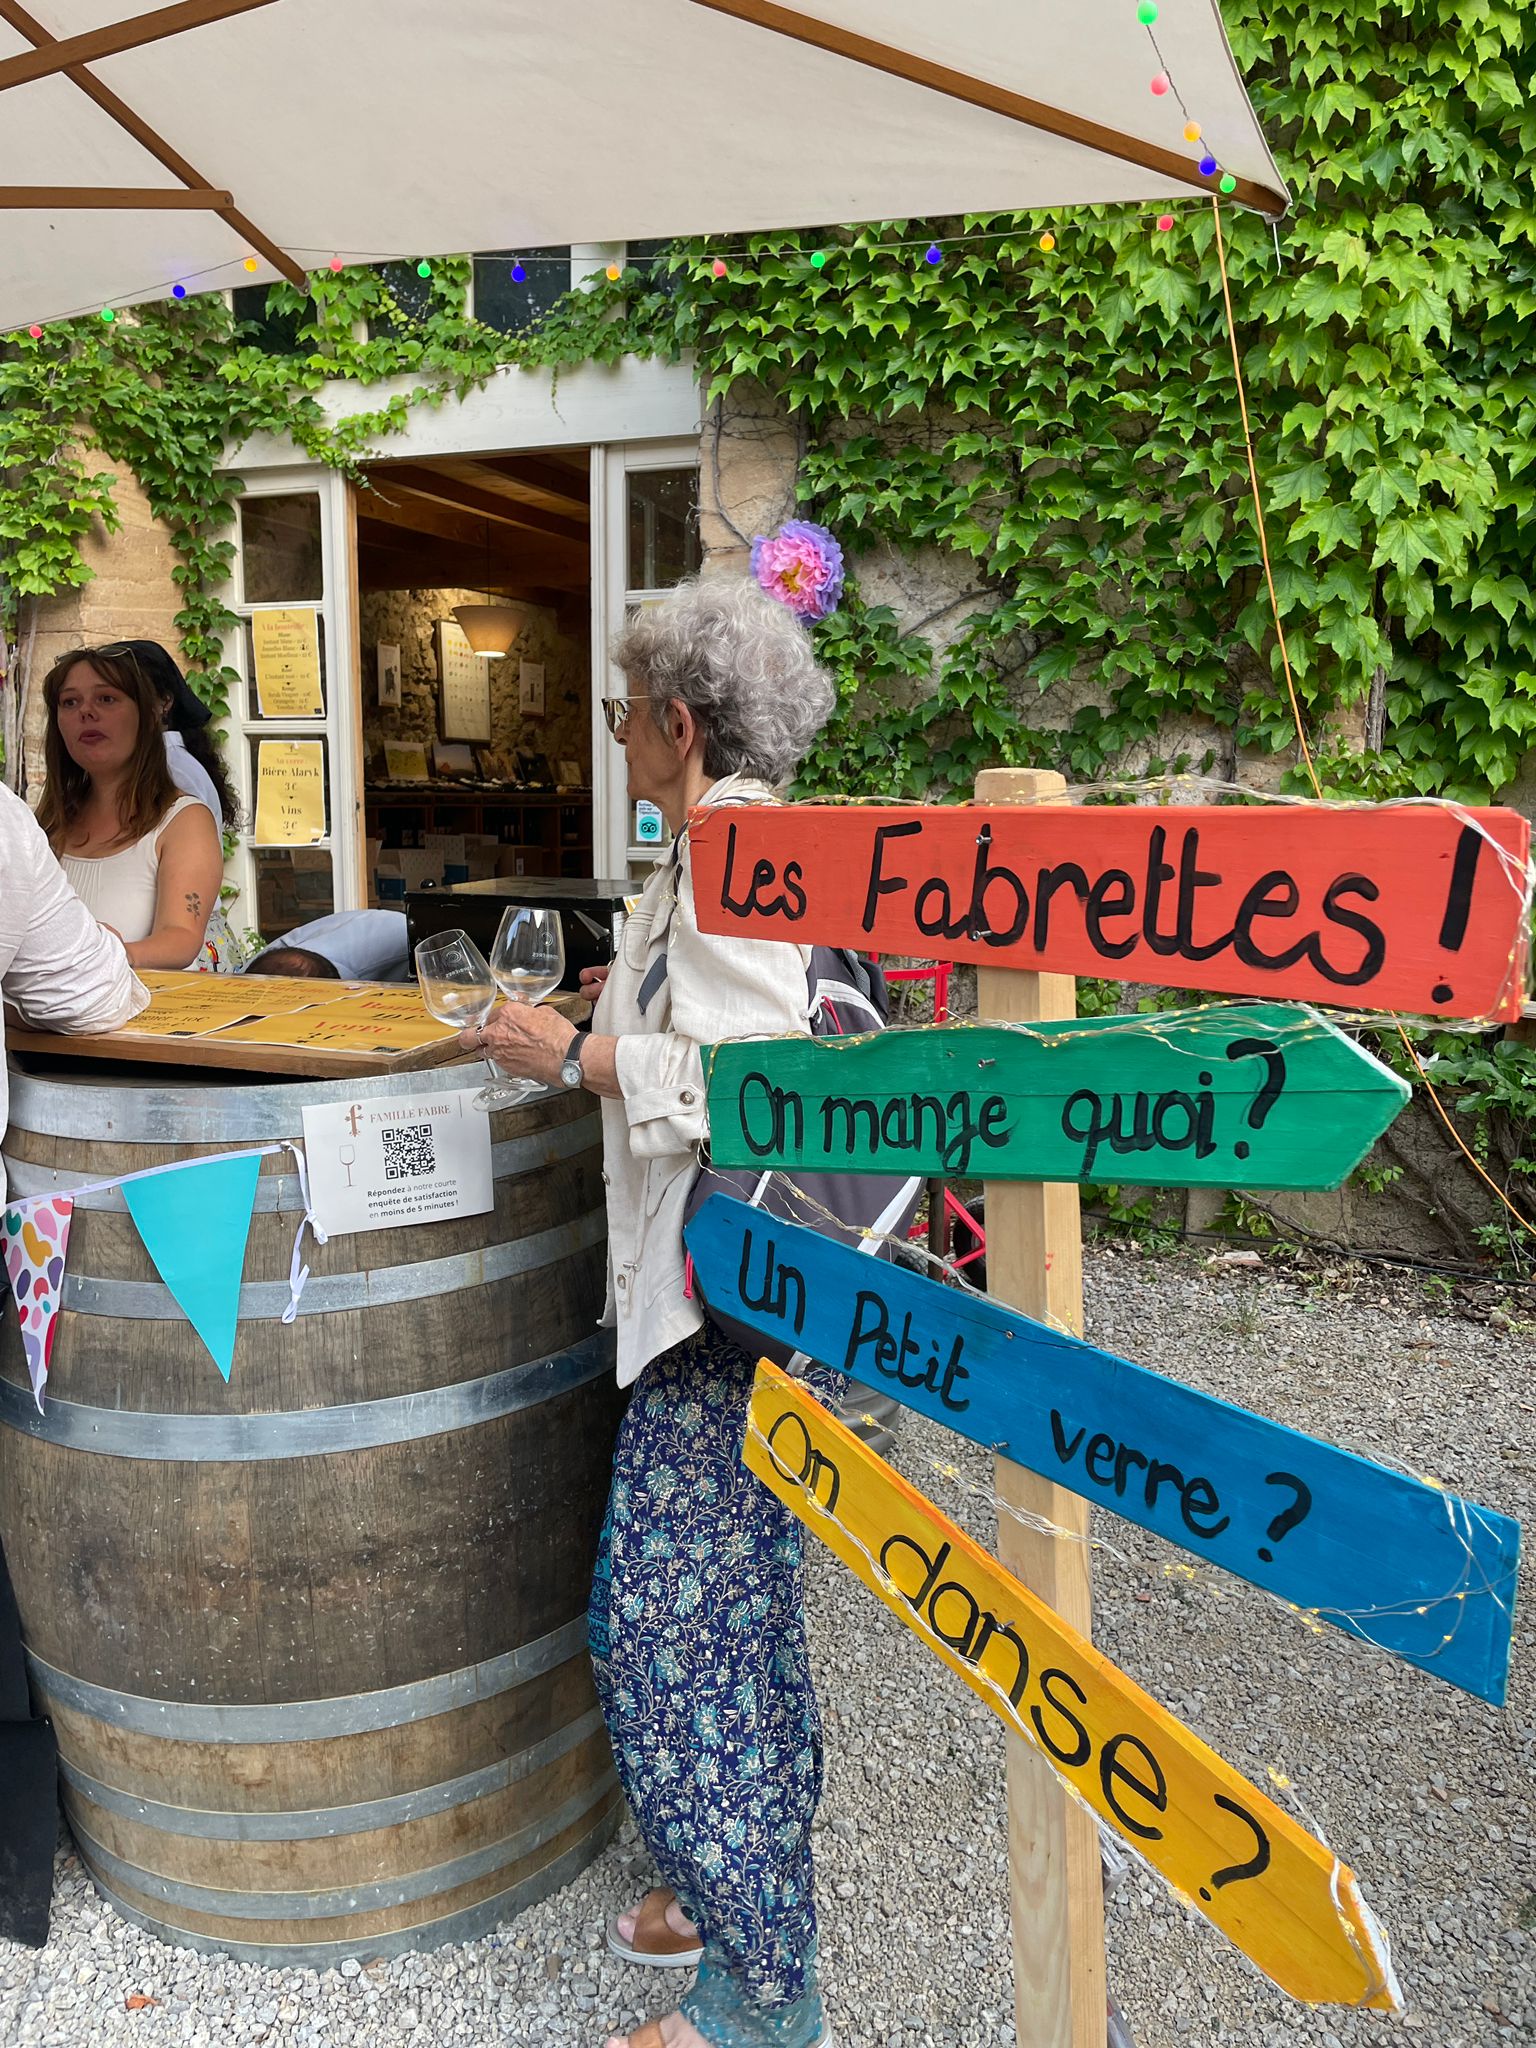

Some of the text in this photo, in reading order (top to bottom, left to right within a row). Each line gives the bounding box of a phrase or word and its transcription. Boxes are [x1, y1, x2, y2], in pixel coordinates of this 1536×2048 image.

[281, 806, 302, 815] Vins
[721, 820, 1482, 1004] Les Fabrettes !
[370, 1104, 451, 1123] FAMILLE FABRE
[739, 1070, 805, 1157] On
[819, 1090, 1015, 1176] mange
[367, 1186, 406, 1199] Répondez
[413, 1183, 433, 1191] notre
[434, 1178, 457, 1188] courte
[368, 1189, 458, 1209] enquête de satisfaction
[369, 1211, 379, 1219] en
[380, 1207, 405, 1217] moins
[406, 1206, 416, 1214] de
[424, 1200, 455, 1211] minutes
[739, 1228, 807, 1331] Un
[844, 1291, 971, 1411] Petit
[1050, 1408, 1231, 1539] verre
[766, 1410, 841, 1514] On
[879, 1534, 1168, 1842] danse
